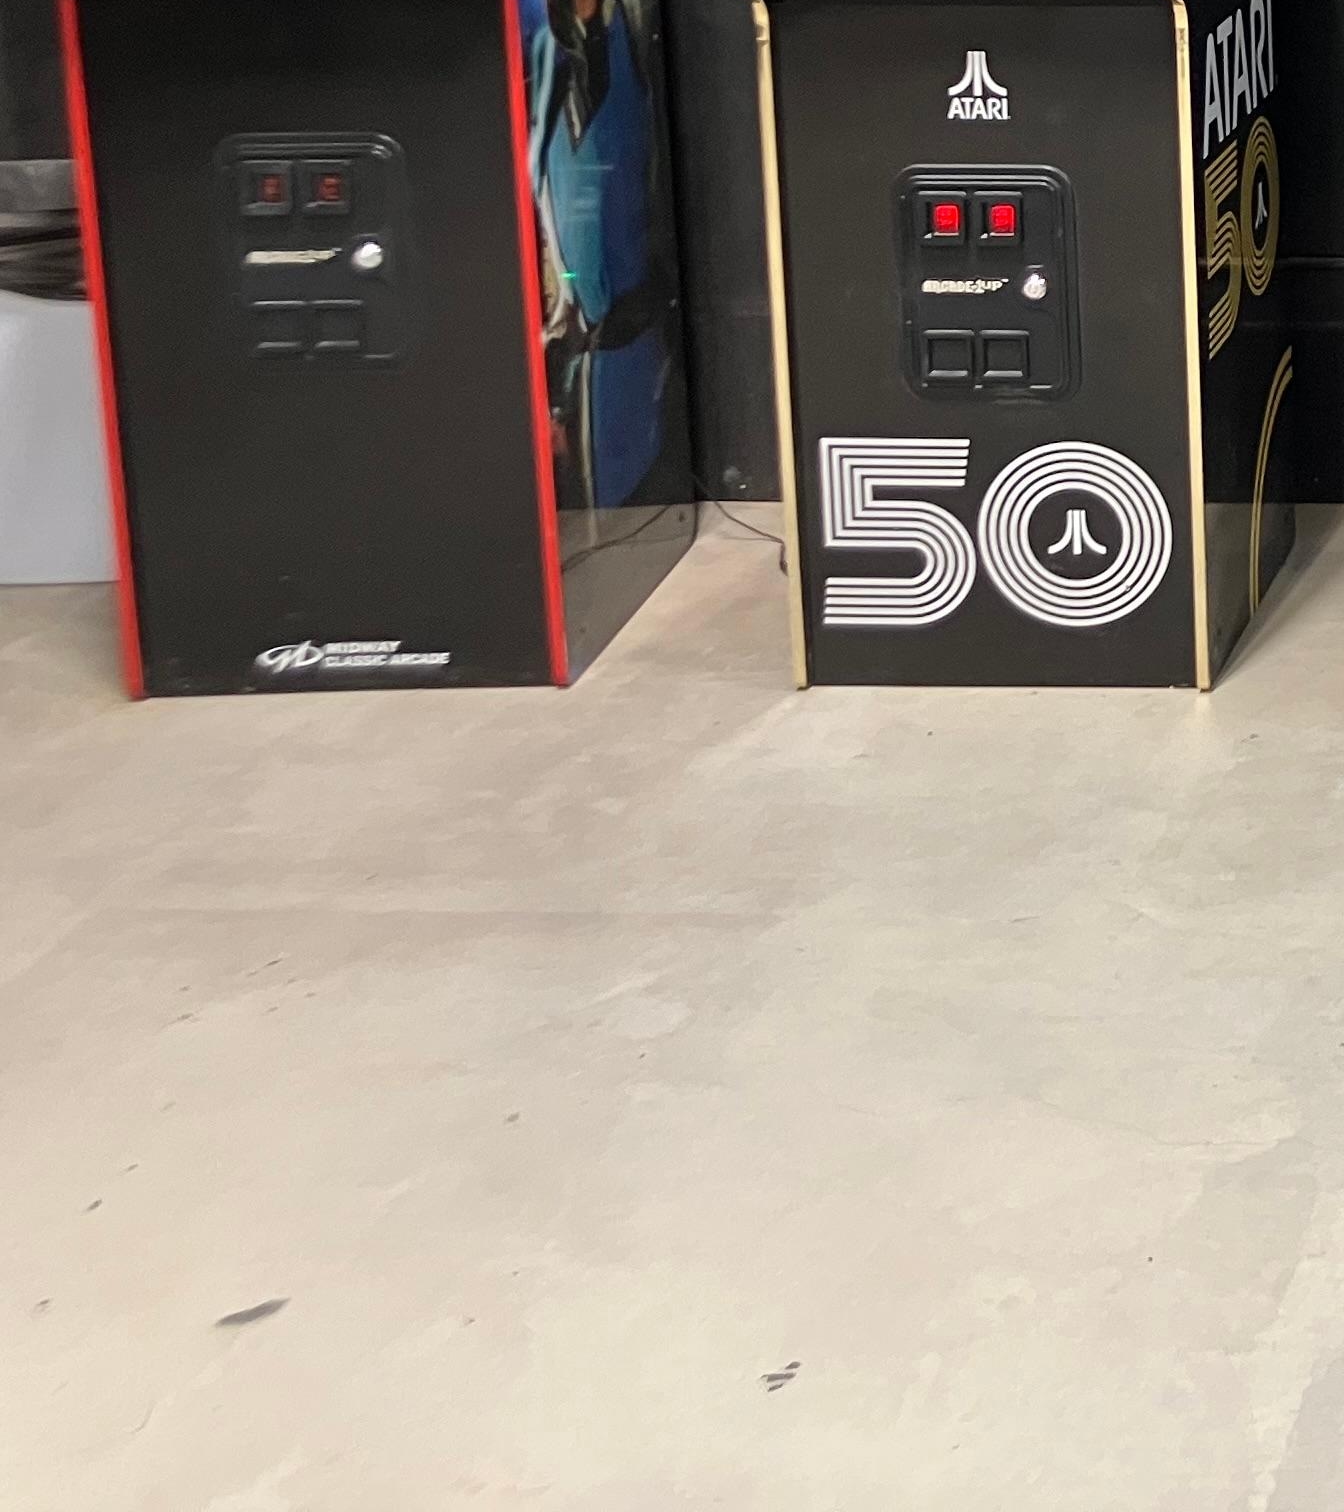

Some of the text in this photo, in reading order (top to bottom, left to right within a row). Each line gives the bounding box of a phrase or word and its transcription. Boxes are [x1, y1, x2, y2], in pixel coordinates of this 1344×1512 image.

[947, 97, 1009, 120] ATARI
[1204, 115, 1281, 361] 50
[818, 437, 1174, 627] 50
[387, 651, 451, 666] ARCADE
